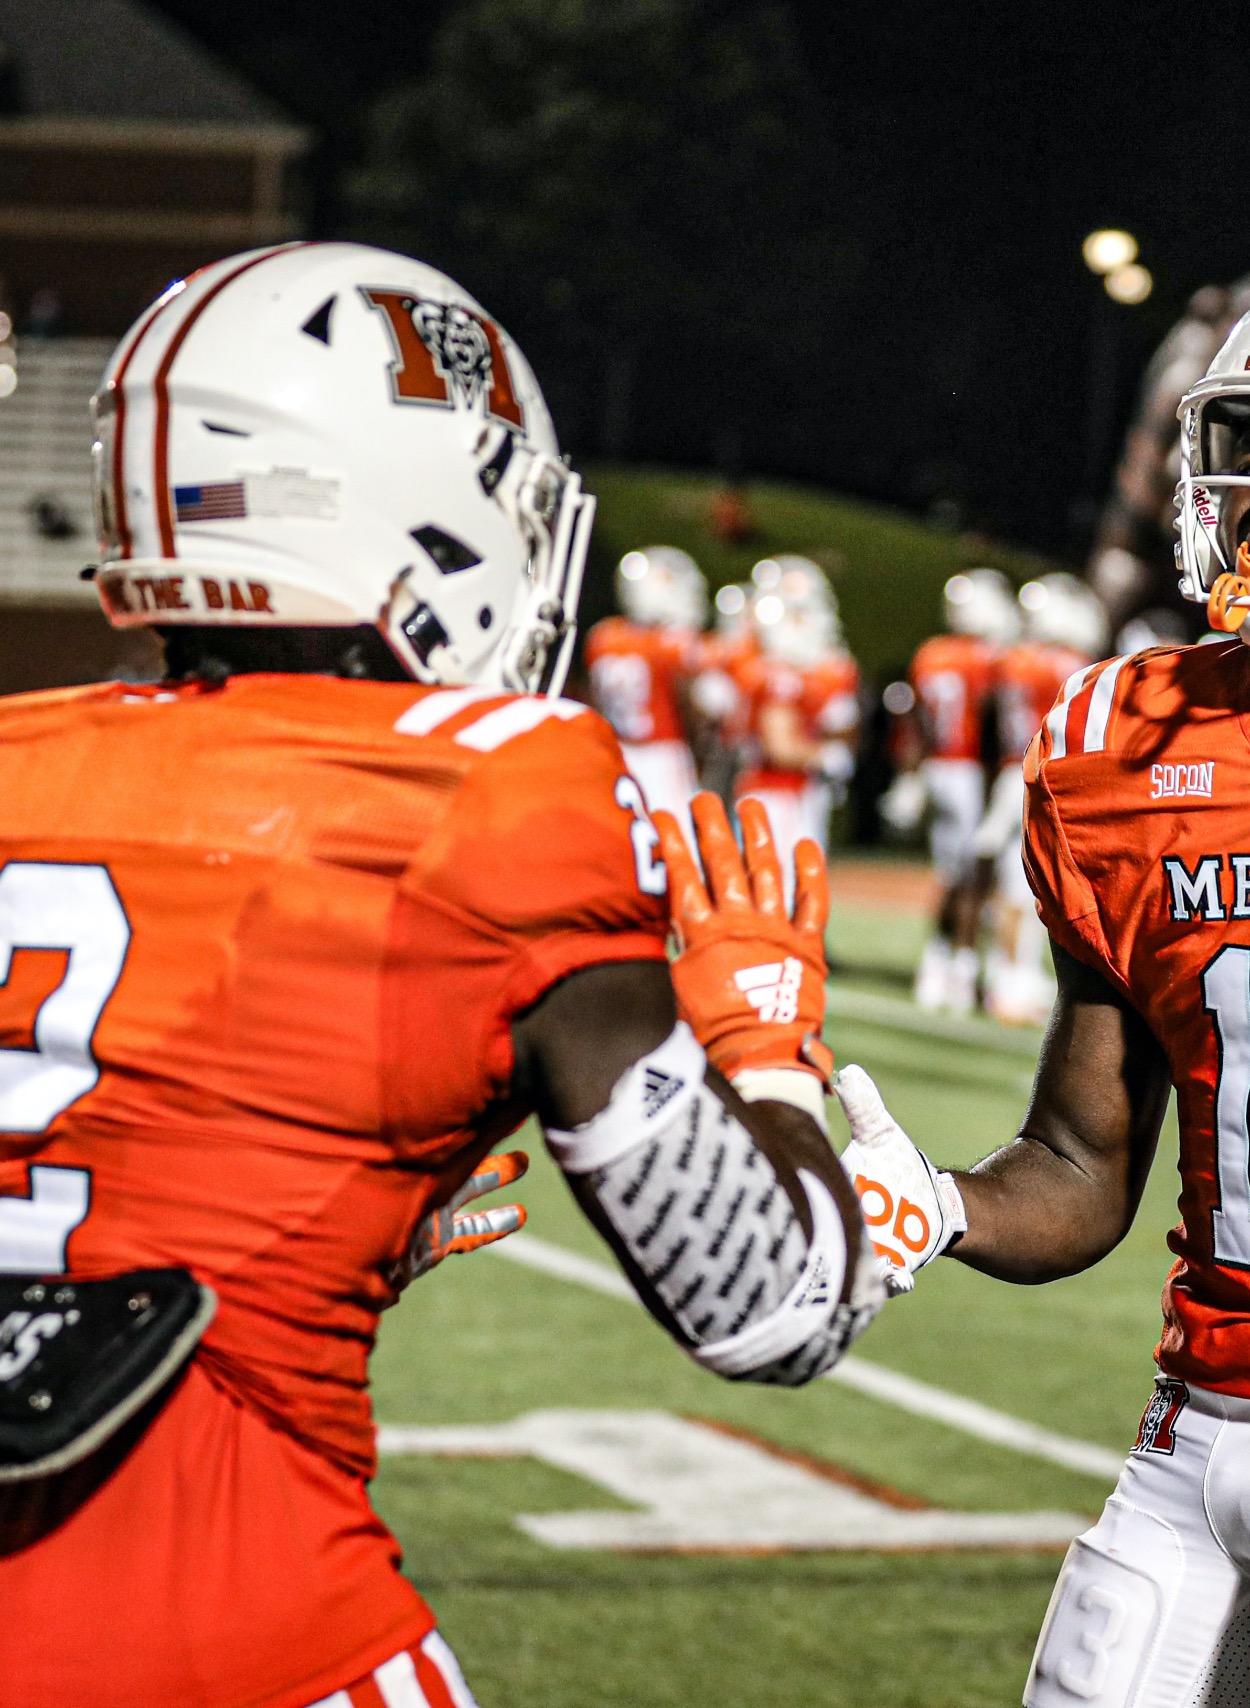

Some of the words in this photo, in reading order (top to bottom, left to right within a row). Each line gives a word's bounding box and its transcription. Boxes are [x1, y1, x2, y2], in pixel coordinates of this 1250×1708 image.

[134, 576, 190, 612] THE
[201, 577, 275, 614] BAR
[1150, 761, 1216, 799] SOCON
